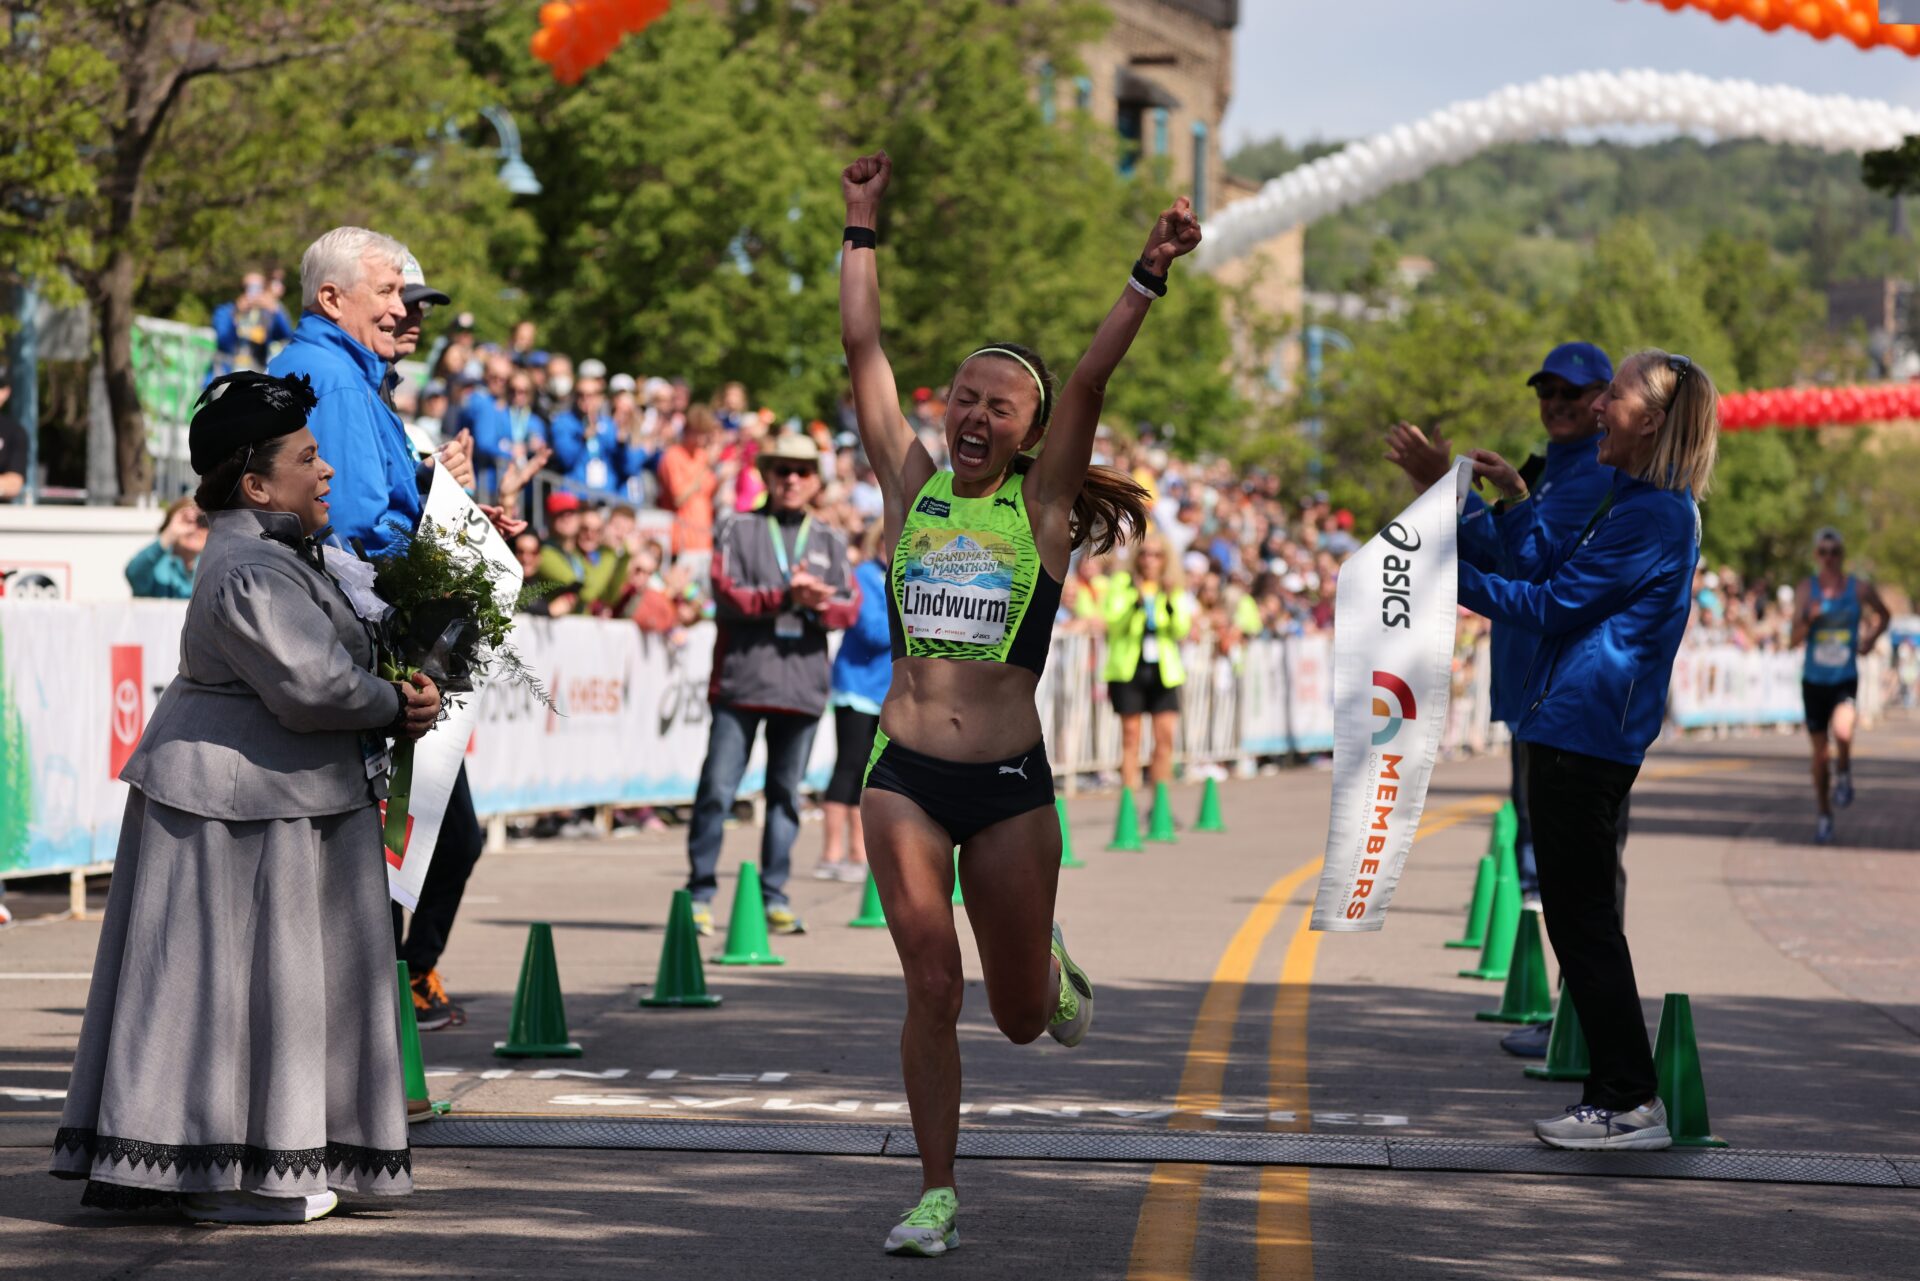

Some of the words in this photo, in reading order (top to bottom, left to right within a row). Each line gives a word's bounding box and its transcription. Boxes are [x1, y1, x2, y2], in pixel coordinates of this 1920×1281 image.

[923, 551, 991, 566] GRANDMA'S
[931, 561, 998, 576] MARATHON
[904, 585, 1007, 623] Lindwurm
[1360, 752, 1378, 834] COOPERATIVE
[1346, 753, 1404, 920] MEMBERS
[1349, 838, 1364, 881] CREDIT
[1336, 882, 1353, 919] UNION
